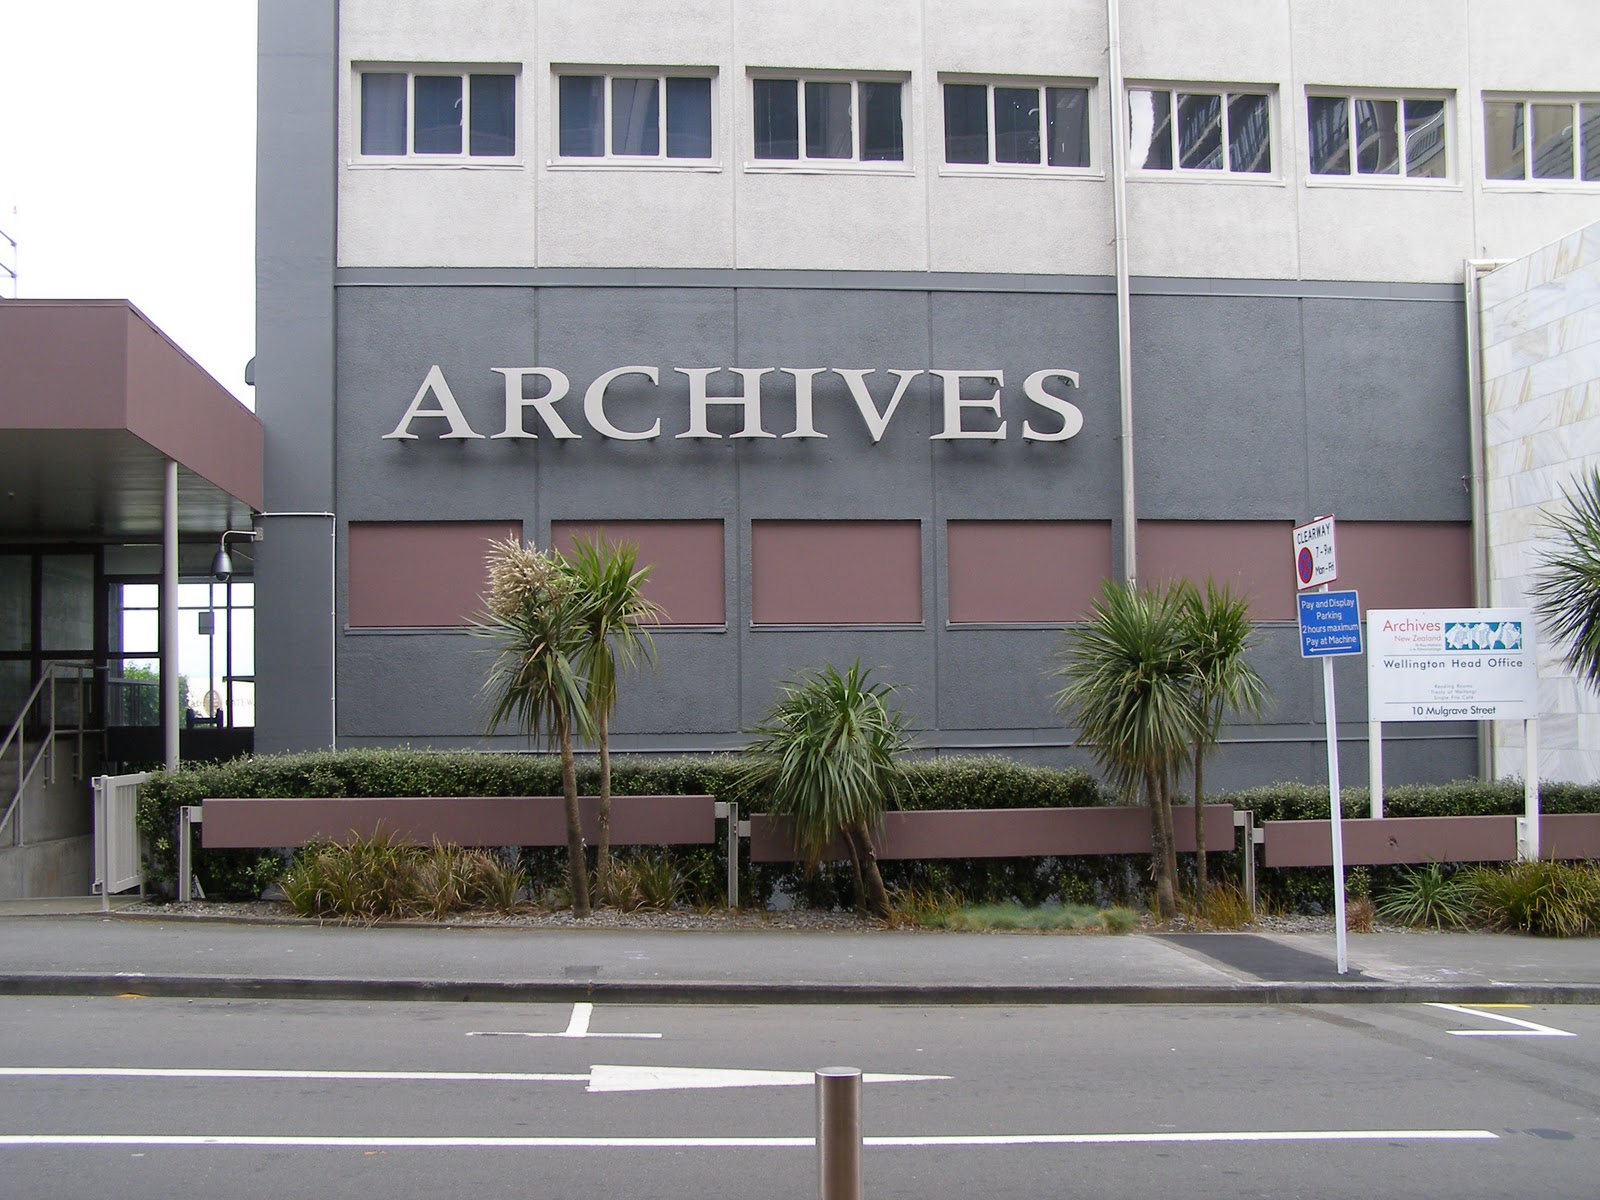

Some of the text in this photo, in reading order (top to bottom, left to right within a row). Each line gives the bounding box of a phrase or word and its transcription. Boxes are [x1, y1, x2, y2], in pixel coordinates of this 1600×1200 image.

[381, 364, 1084, 443] ARCHIVES
[1297, 523, 1331, 545] CLEARWAY
[1301, 598, 1354, 611] Pay and Display
[1316, 611, 1342, 621] Parking
[1302, 623, 1359, 634] 2 hours maximum
[1383, 619, 1441, 632] Archives
[1306, 635, 1357, 647] Pay at Machine
[1412, 634, 1441, 642] Zealand
[1383, 658, 1523, 670] Wellington Head Office
[1412, 705, 1496, 717] 10 Mulgrave Street
